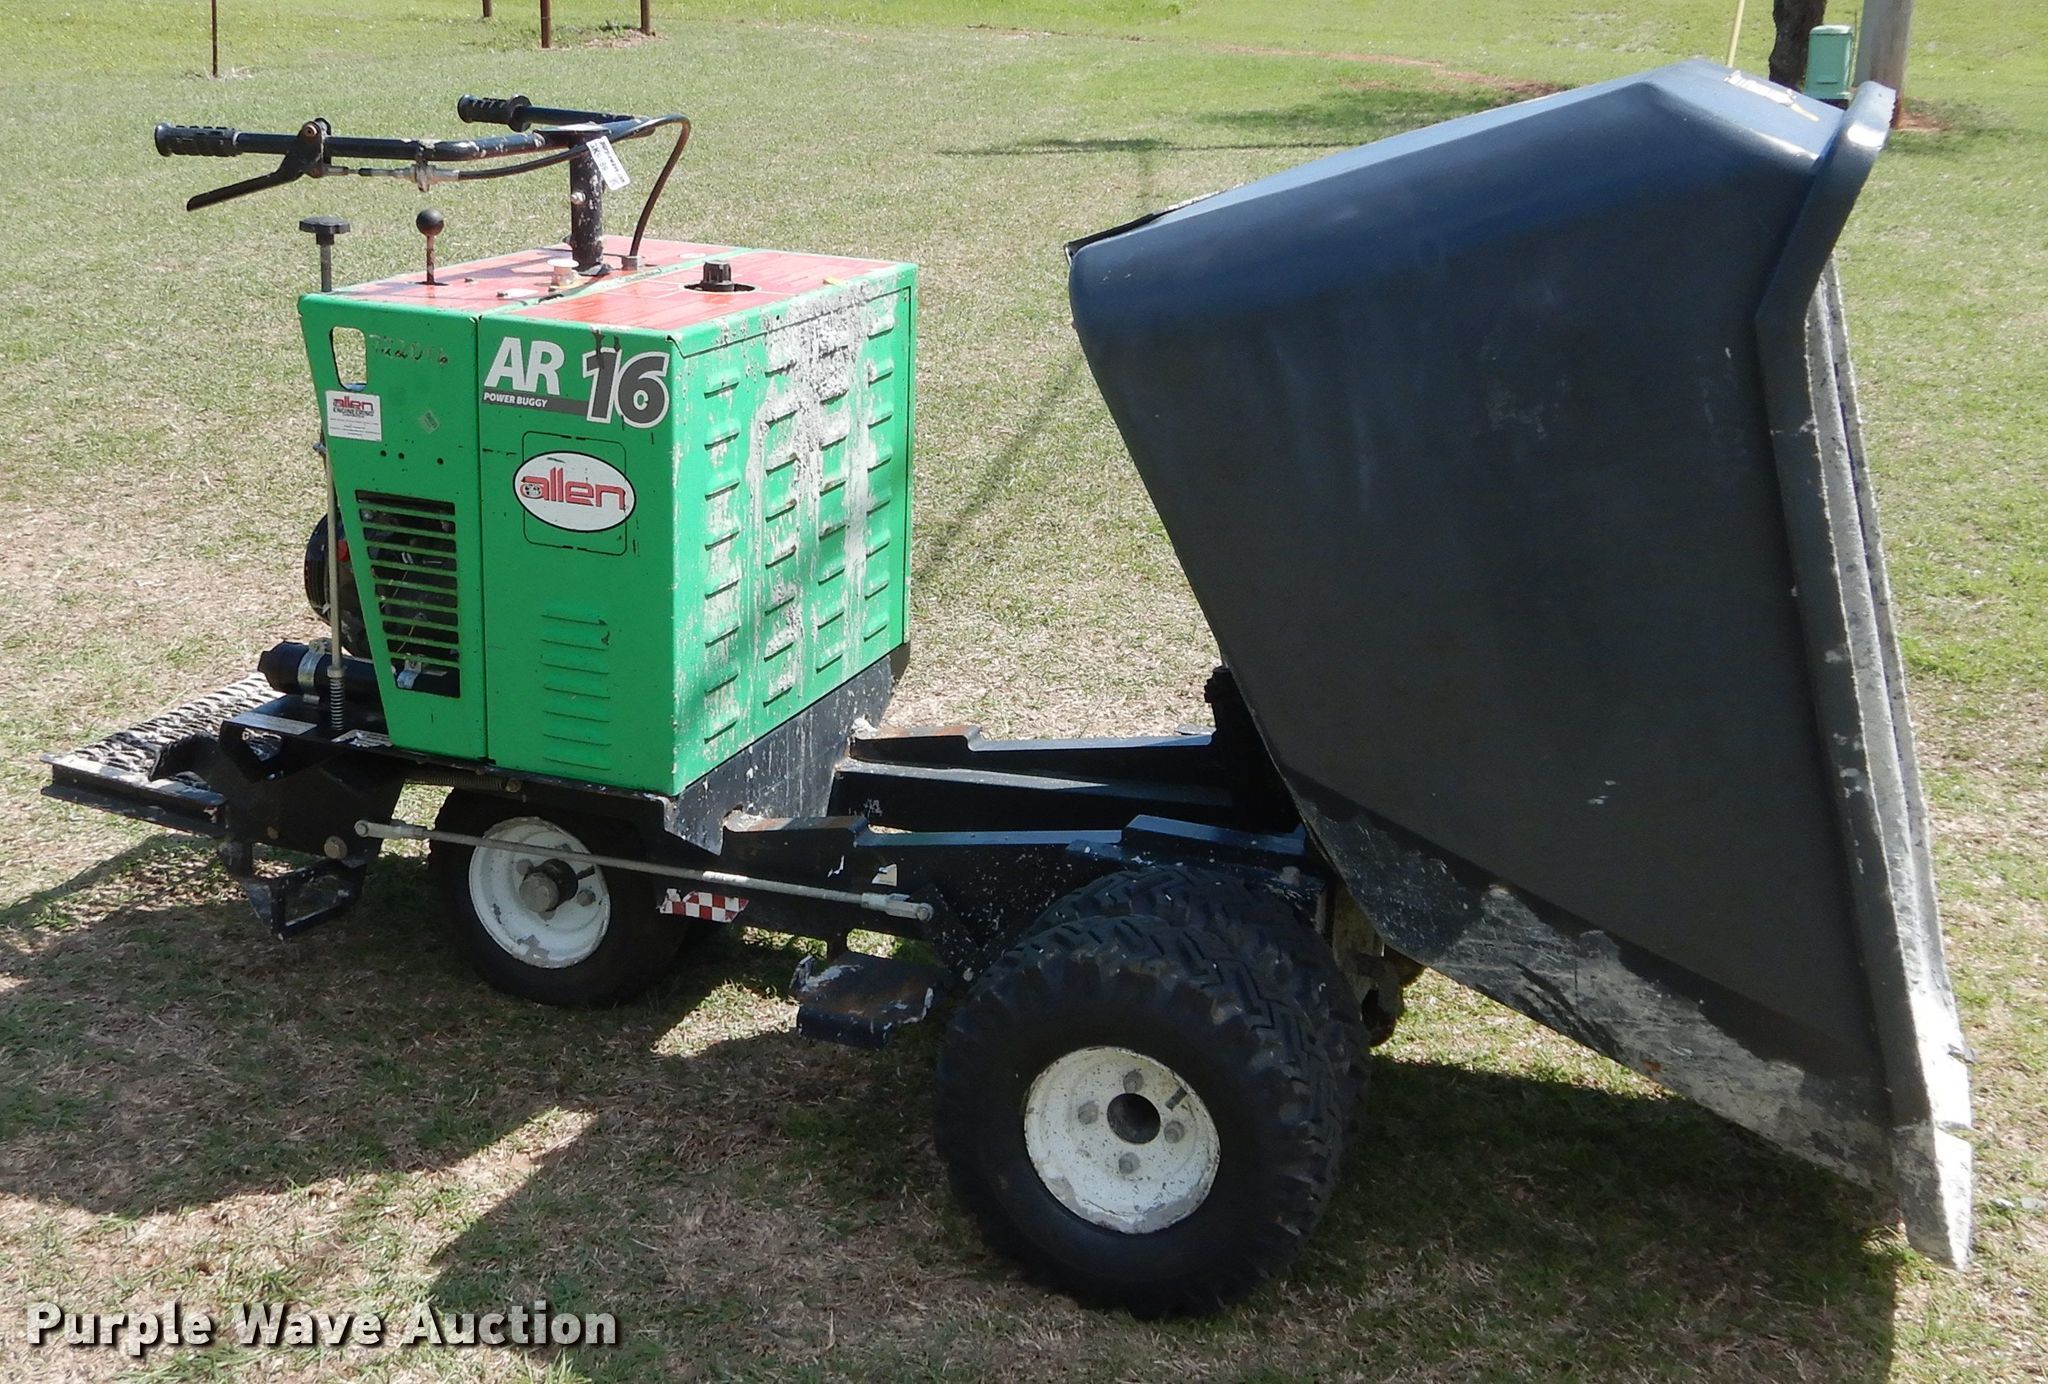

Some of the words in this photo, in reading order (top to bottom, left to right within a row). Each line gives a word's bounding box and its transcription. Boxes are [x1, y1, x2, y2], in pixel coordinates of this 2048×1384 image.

[484, 336, 565, 396] AR
[582, 346, 671, 429] 16
[333, 395, 374, 411] allen
[483, 391, 516, 405] POWER
[516, 395, 548, 408] BUGGY
[333, 406, 375, 417] ENGINEERING
[520, 466, 626, 511] allen
